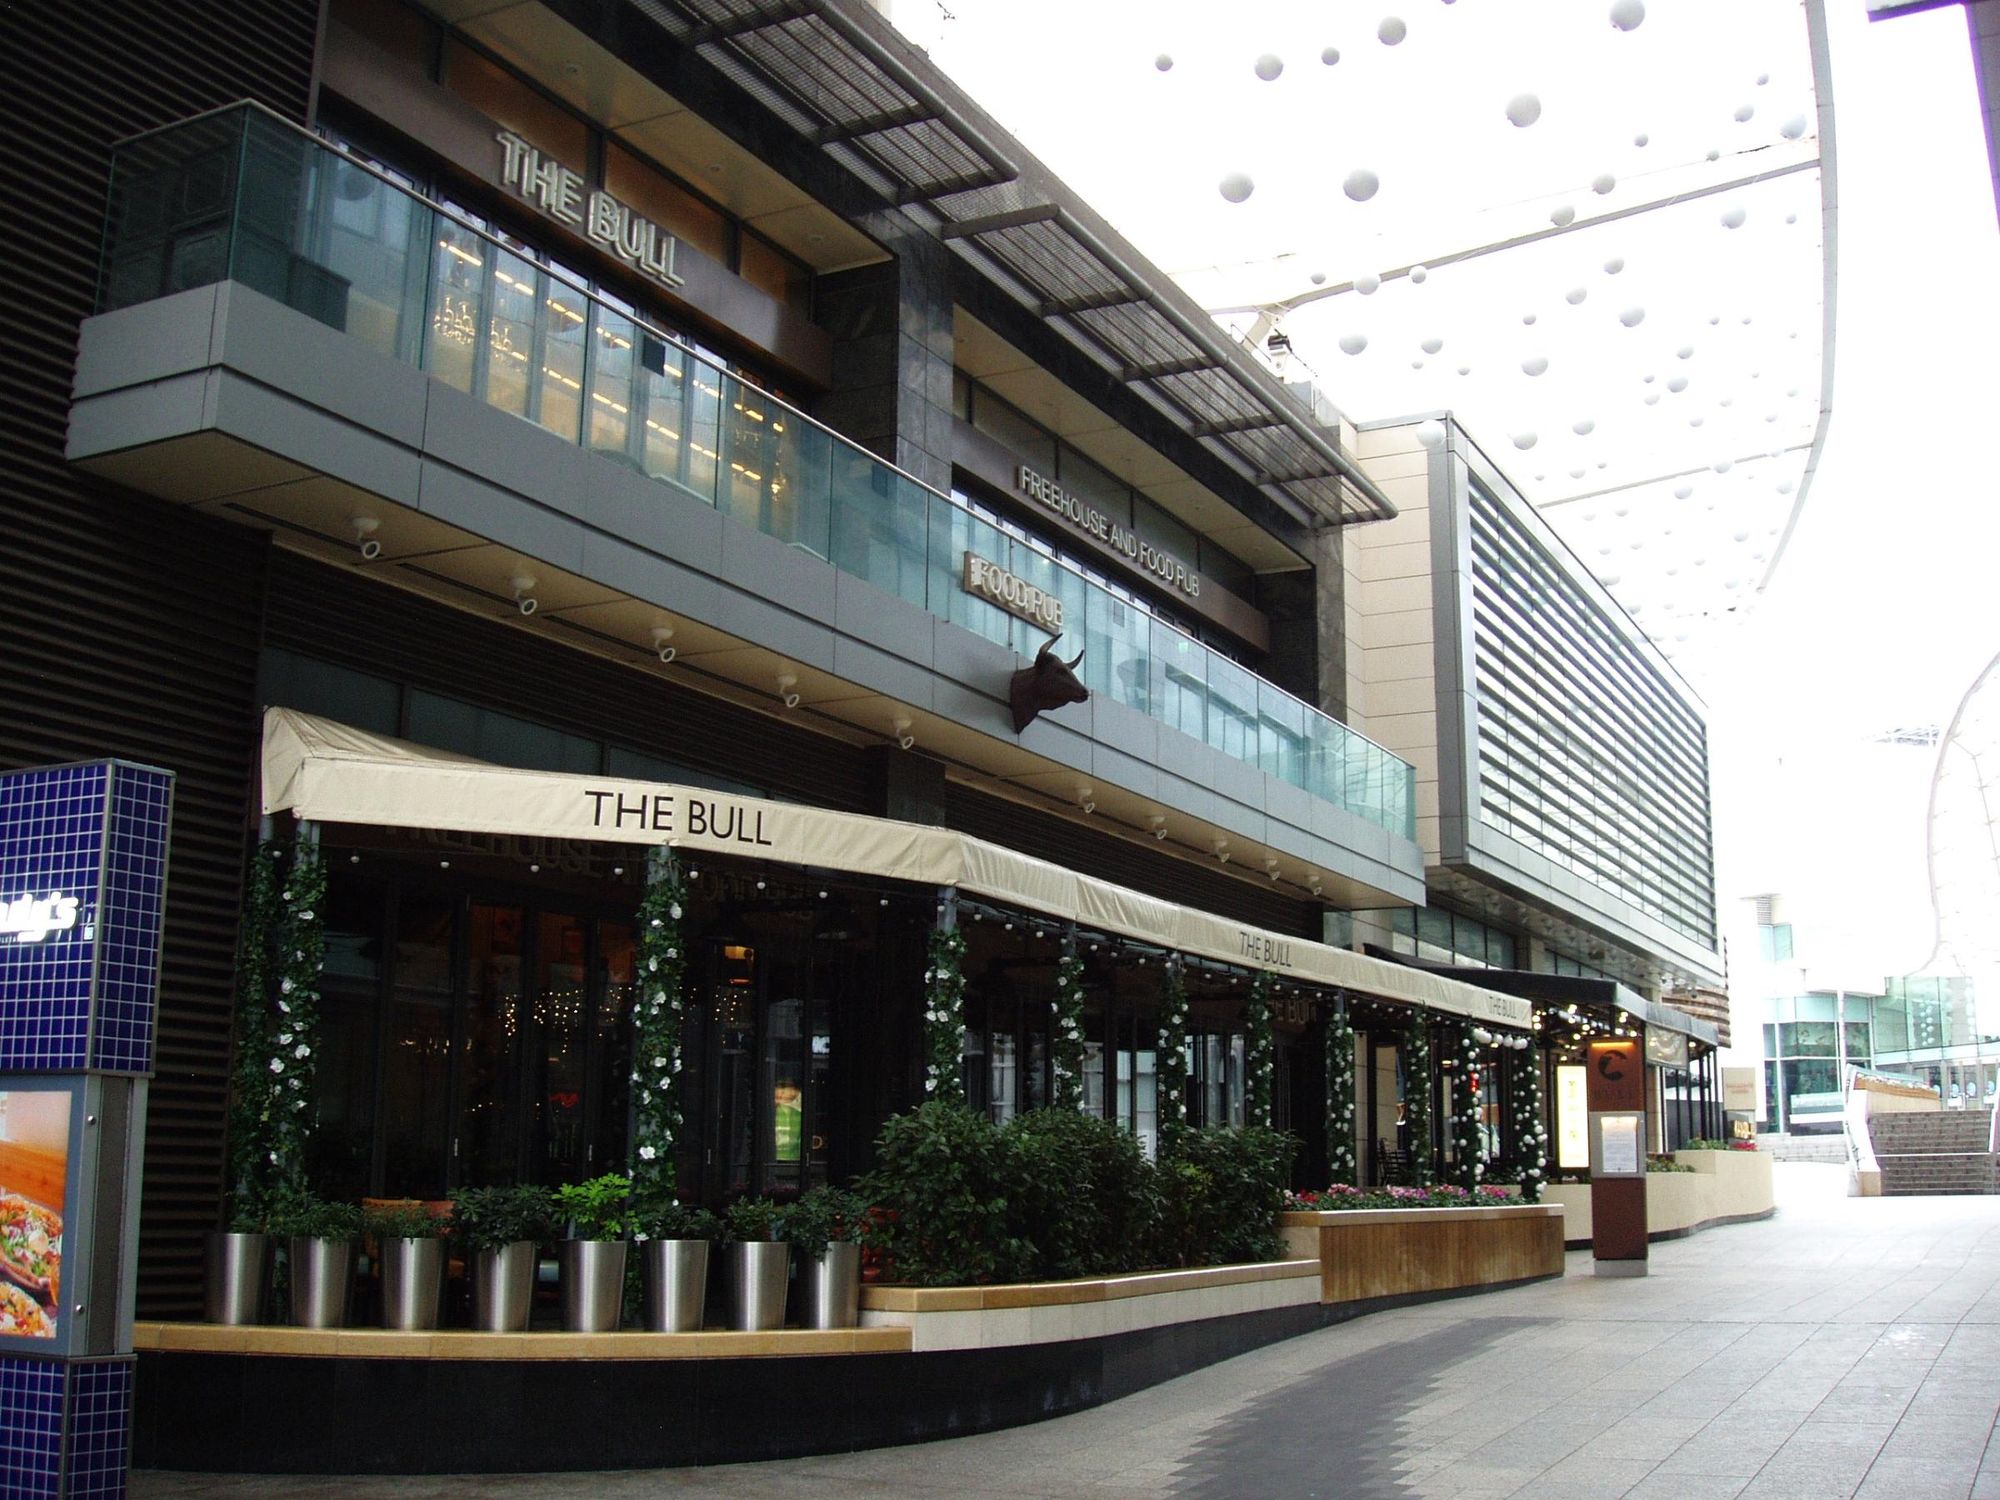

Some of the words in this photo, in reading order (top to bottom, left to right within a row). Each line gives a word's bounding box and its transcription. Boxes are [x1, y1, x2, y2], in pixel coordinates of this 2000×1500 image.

[497, 131, 584, 225] THE
[586, 189, 685, 289] BULL
[1021, 465, 1108, 541] FREEHOUSE
[1109, 524, 1138, 558] AND
[1138, 541, 1174, 582] FOOD
[1175, 563, 1200, 598] PUB
[971, 556, 1028, 606] FOOD
[1028, 586, 1064, 626] PUB
[585, 790, 674, 832] THE
[688, 799, 772, 847] BULL
[1240, 931, 1261, 960] THE
[1264, 939, 1292, 967] BULL
